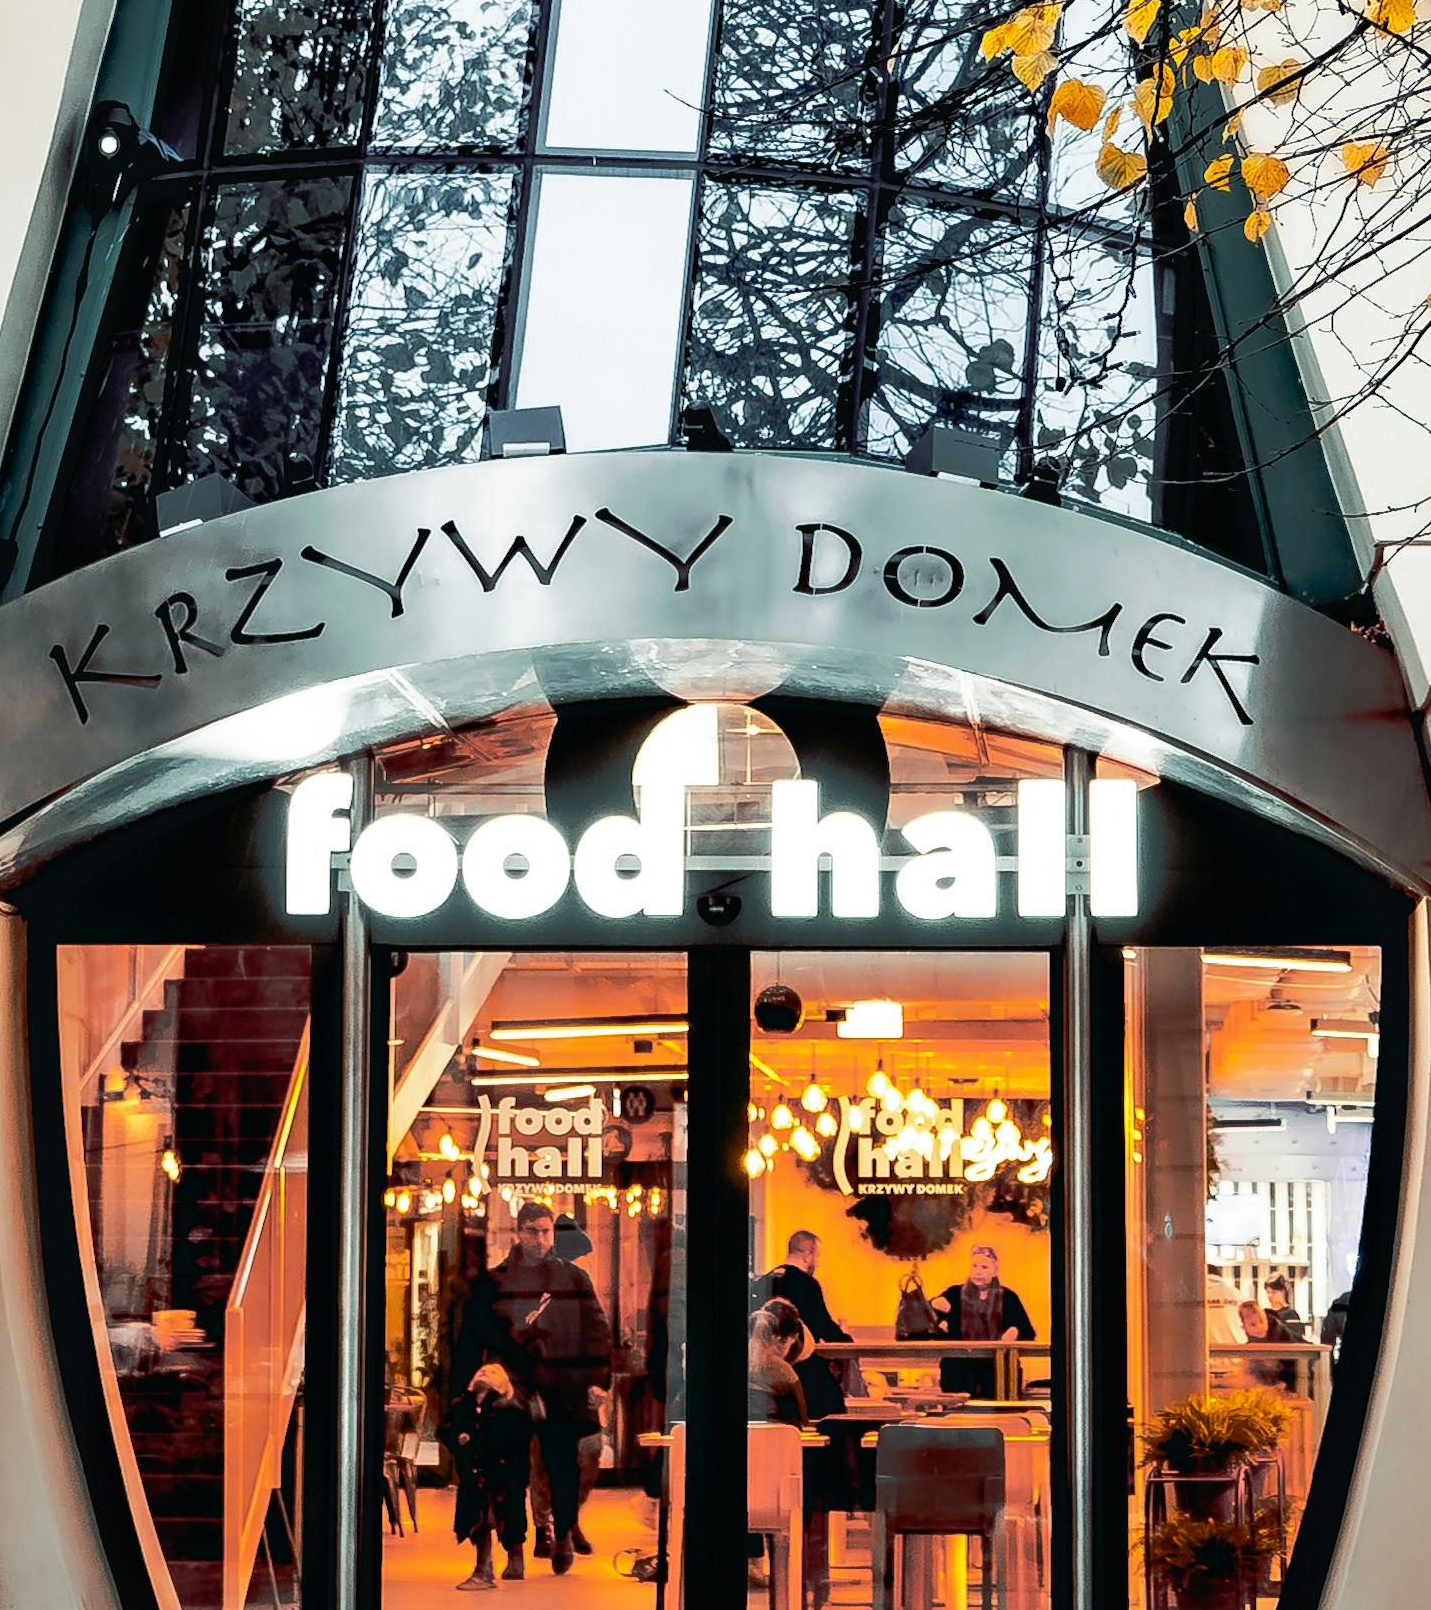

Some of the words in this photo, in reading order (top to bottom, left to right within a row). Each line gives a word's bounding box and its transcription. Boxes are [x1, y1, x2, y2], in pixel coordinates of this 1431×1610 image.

[50, 504, 733, 724] KRZYWY
[794, 522, 1261, 727] DOMEK
[284, 772, 690, 920] food
[771, 778, 1139, 920] hall
[497, 1096, 603, 1136] food
[857, 1097, 965, 1136] food
[497, 1136, 603, 1178] hall
[857, 1136, 965, 1179] hall
[857, 1183, 916, 1195] KRZYWY
[915, 1183, 965, 1195] DOMEK
